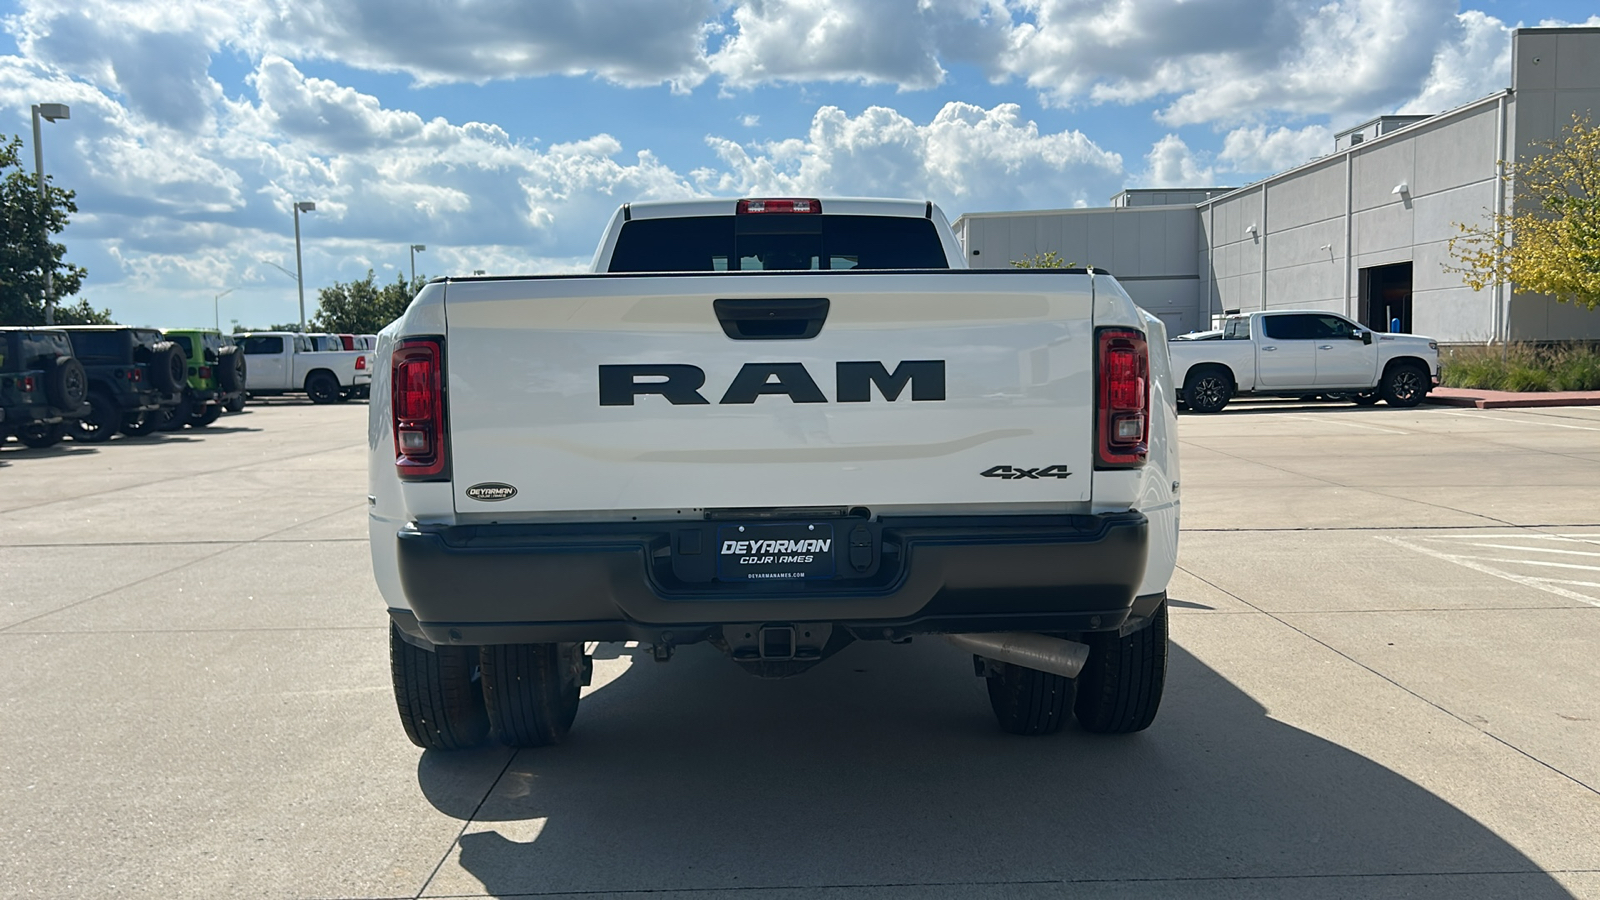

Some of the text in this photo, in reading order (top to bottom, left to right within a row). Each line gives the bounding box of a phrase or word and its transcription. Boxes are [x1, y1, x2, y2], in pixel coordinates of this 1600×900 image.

[598, 360, 946, 406] RAM
[980, 465, 1073, 480] 4x4
[469, 487, 513, 495] DEYARMAN
[720, 539, 831, 554] DEYARMAN
[778, 555, 814, 563] AMES
